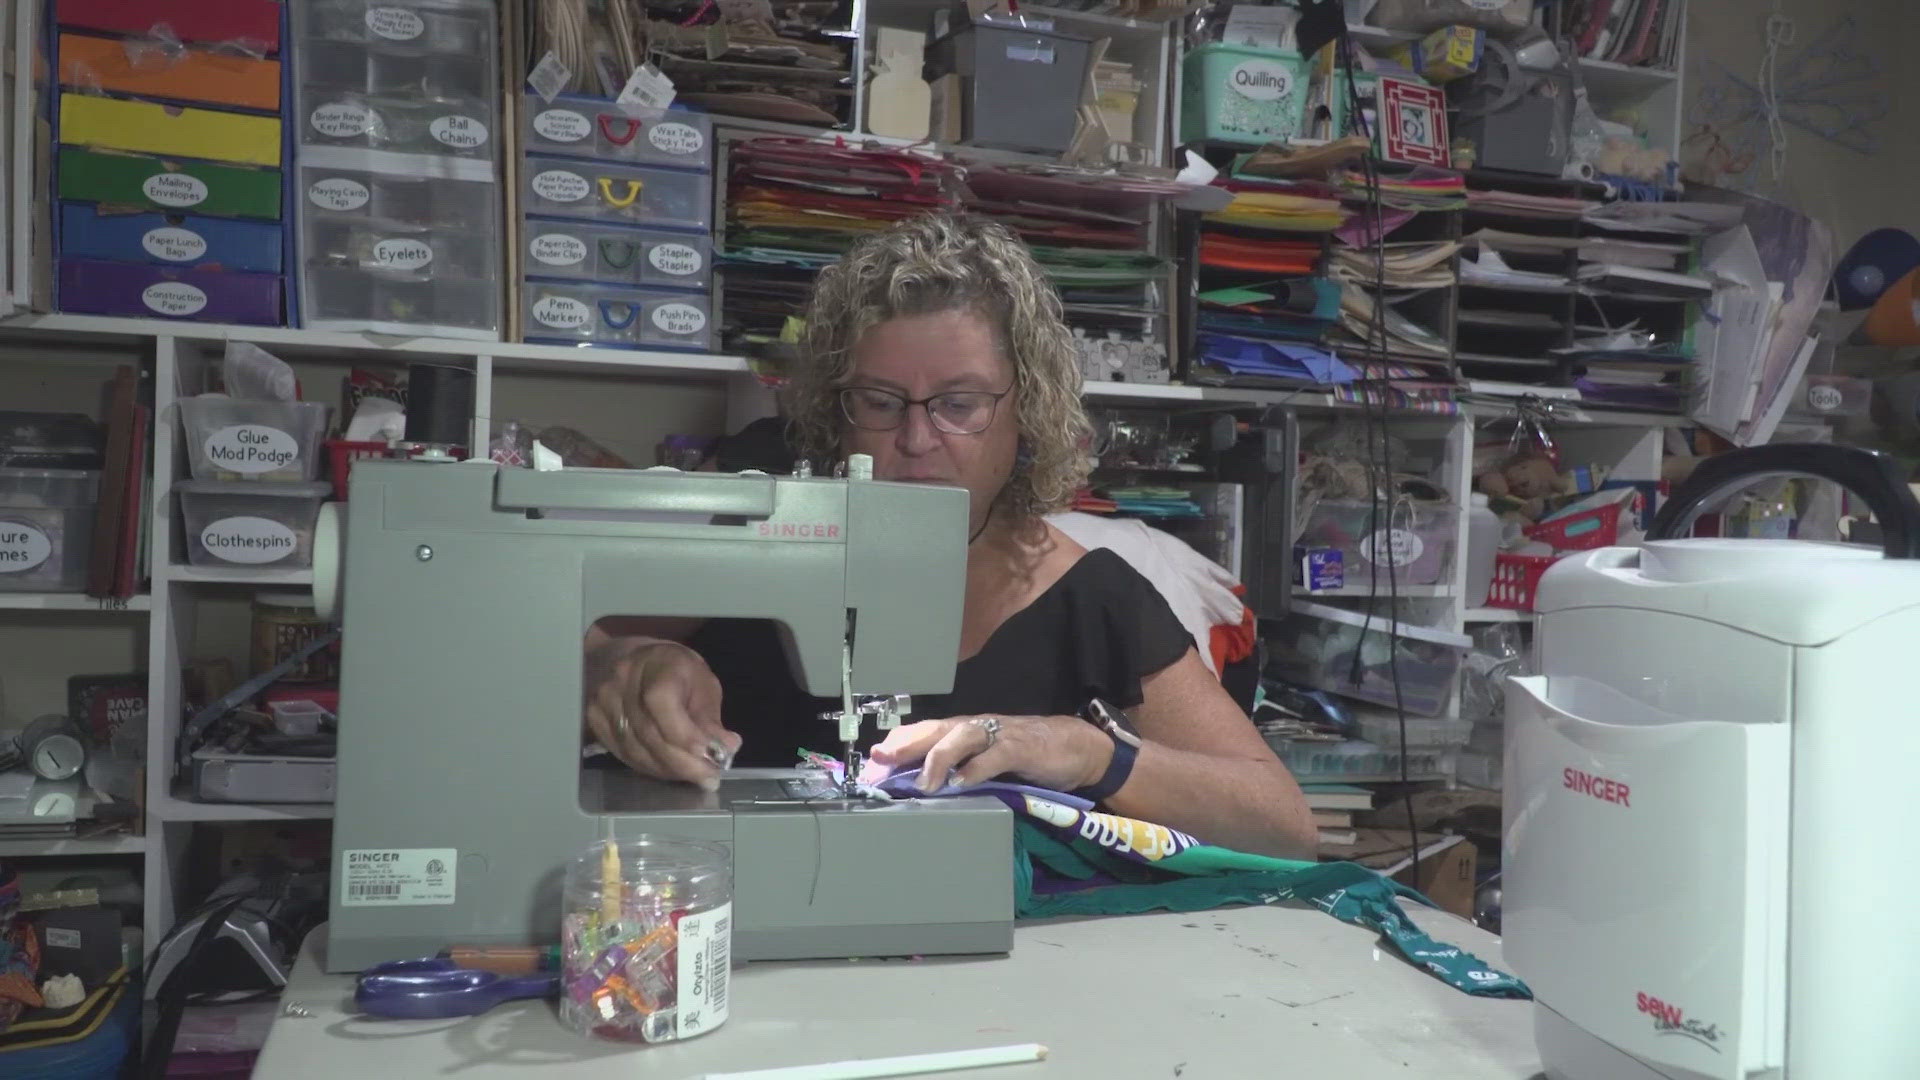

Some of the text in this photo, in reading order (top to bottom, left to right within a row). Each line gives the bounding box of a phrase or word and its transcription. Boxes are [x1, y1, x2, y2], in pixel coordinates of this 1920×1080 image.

[1235, 69, 1286, 92] Quilling
[315, 111, 365, 122] Binder Rings
[320, 123, 362, 133] Key Rings
[449, 118, 469, 130] Ball
[439, 130, 478, 145] Chains
[656, 126, 697, 139] Wax Tabs
[652, 136, 699, 149] Sticky Tack
[158, 176, 193, 192] Mailing
[150, 187, 200, 201] Envelopes
[311, 186, 368, 199] Playing Cards
[329, 197, 350, 208] Tags
[149, 235, 203, 249] Paper Lunch
[538, 239, 580, 252] Paperclips
[165, 247, 187, 258] Bags
[379, 246, 428, 264] Eyelets
[535, 249, 583, 260] Binder Clips
[659, 247, 694, 260] Stapler
[658, 259, 695, 272] Staples
[146, 289, 204, 304] Construction
[161, 301, 187, 312] Paper
[550, 298, 575, 311] Pens
[539, 311, 584, 323] Markers
[660, 308, 701, 321] Push Pins
[667, 321, 694, 332] Brads
[1811, 391, 1839, 405] Tools
[237, 429, 270, 444] Glue
[211, 445, 294, 467] Mod Podge
[759, 522, 841, 537] SINGER
[205, 533, 292, 551] Clothespins
[1563, 766, 1631, 808] SINGER
[349, 852, 400, 863] SINGER
